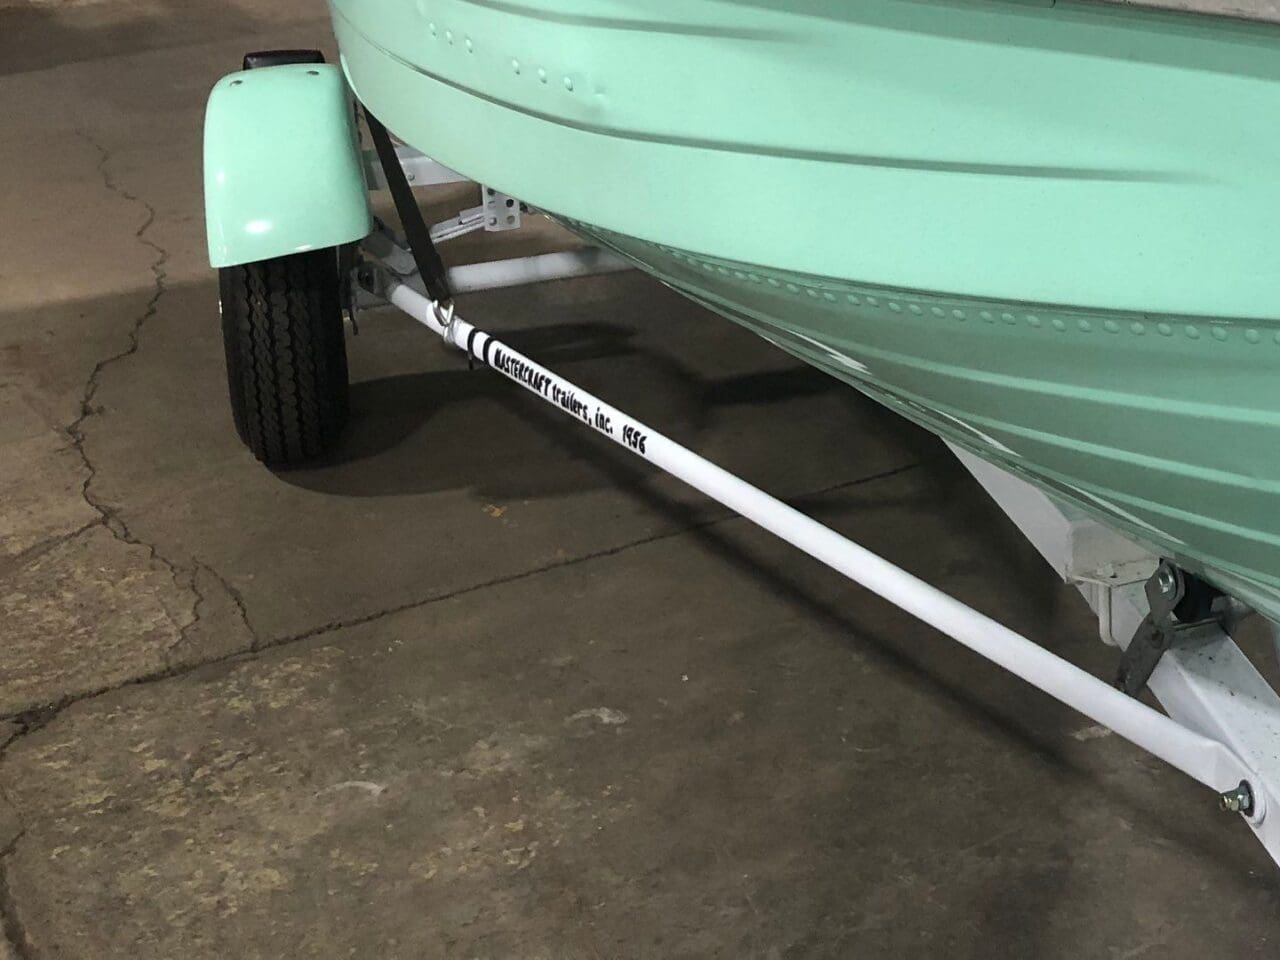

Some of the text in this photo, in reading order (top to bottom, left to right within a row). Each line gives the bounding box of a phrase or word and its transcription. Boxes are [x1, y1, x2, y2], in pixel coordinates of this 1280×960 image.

[494, 347, 648, 454] MASTERCRAFT trailers, inc. 1956
